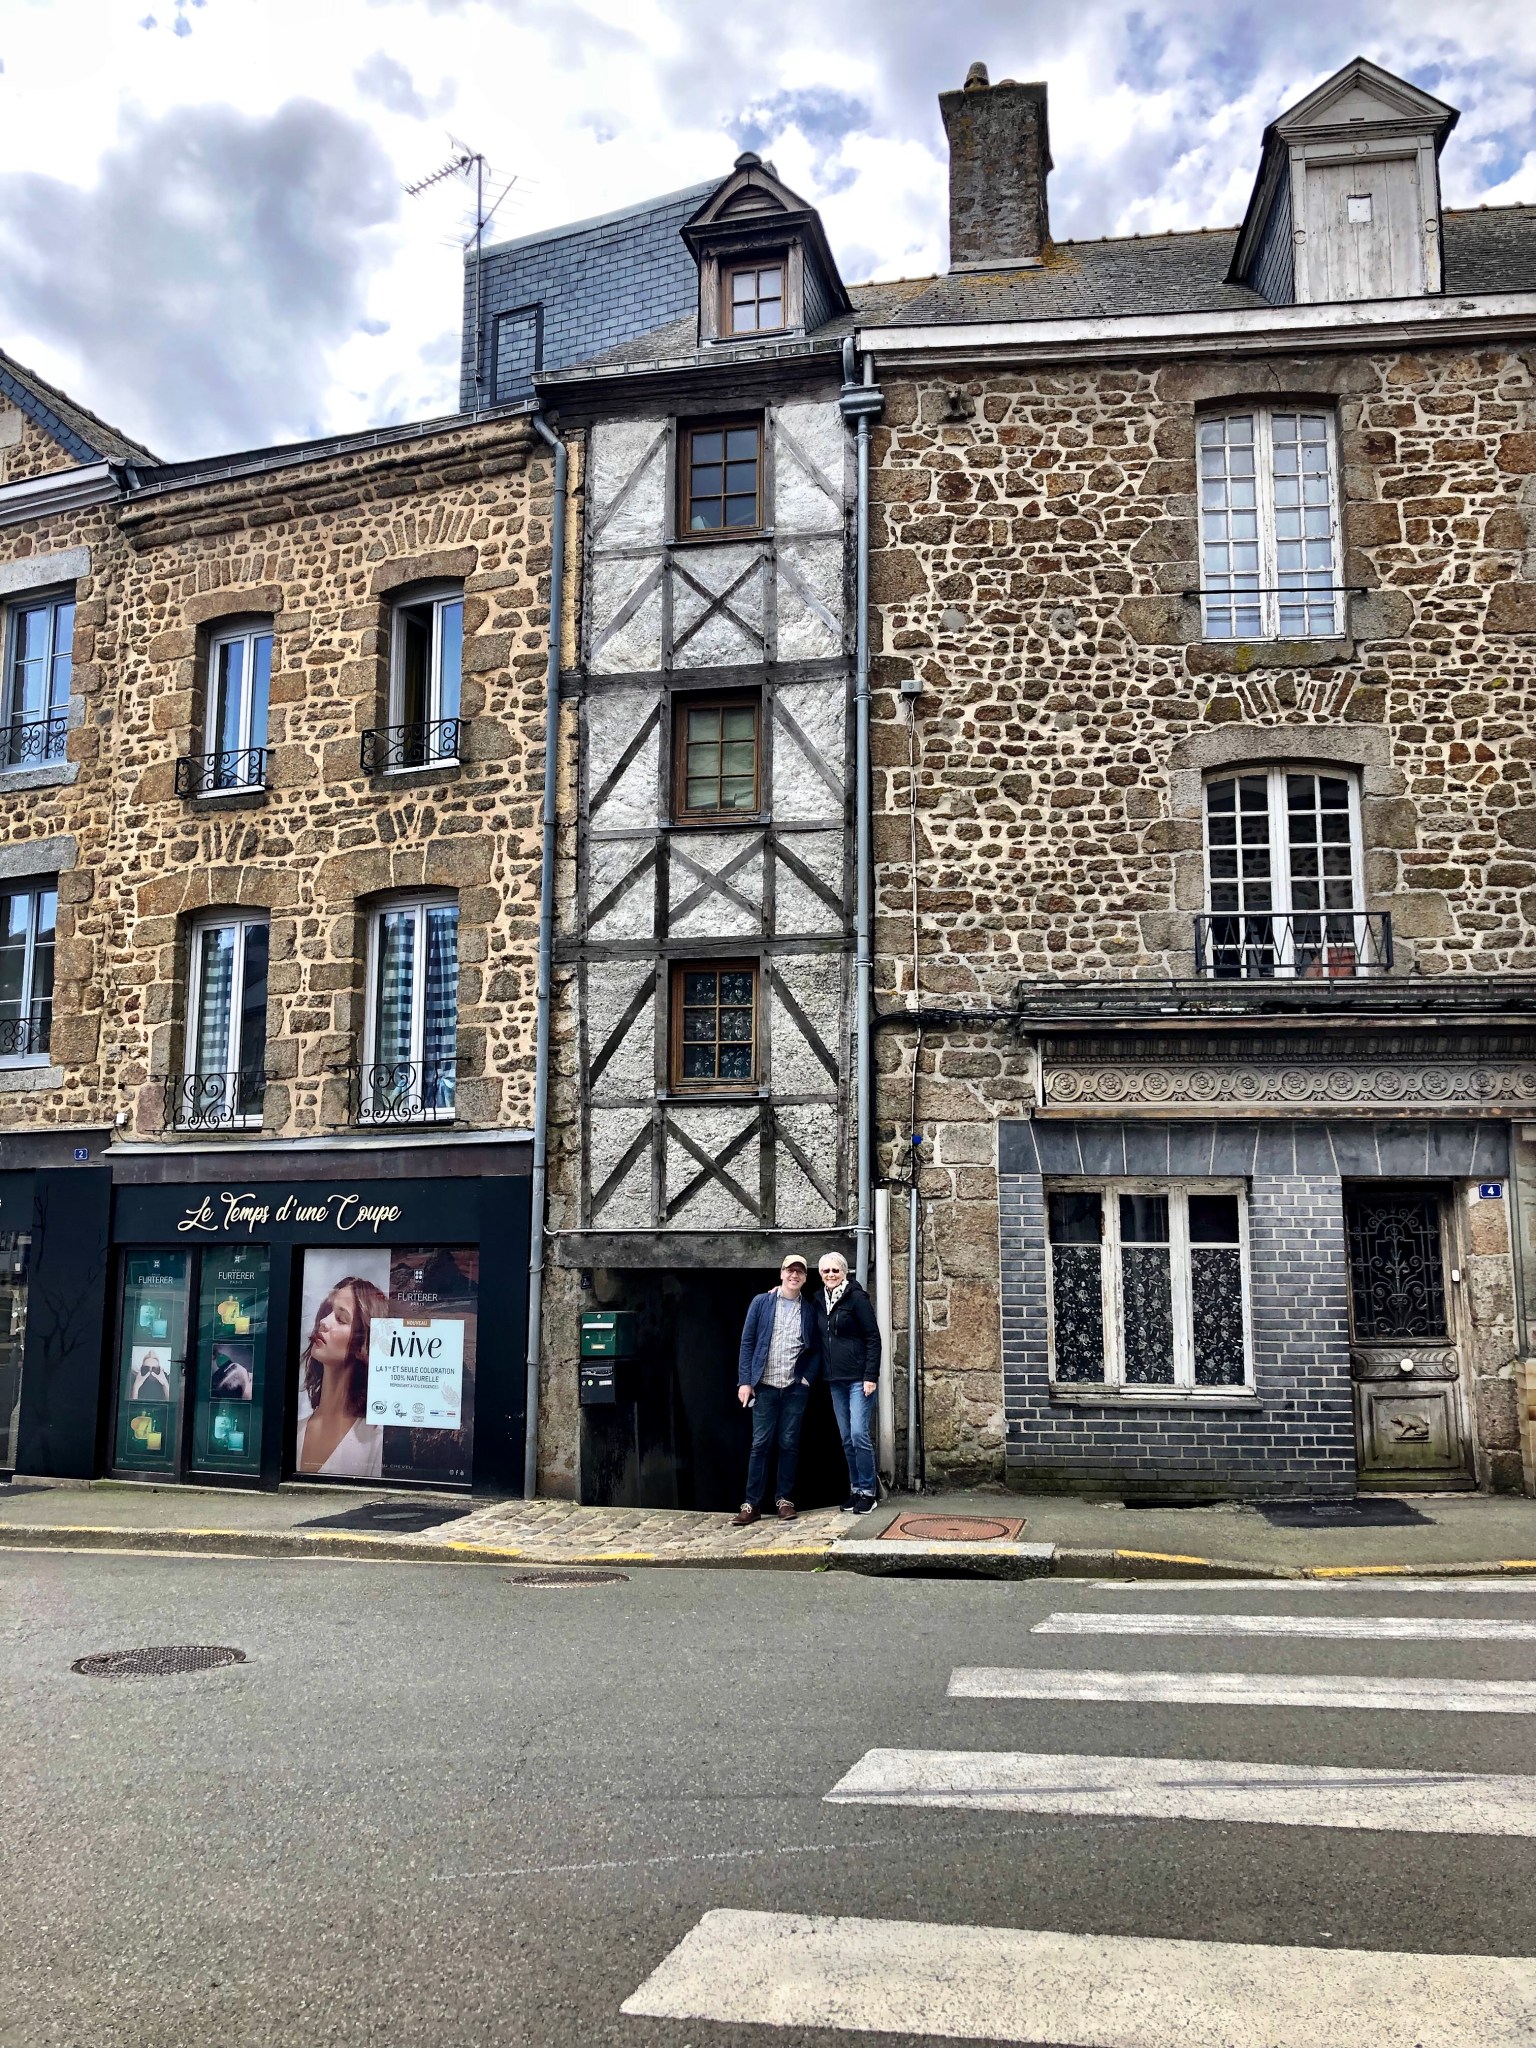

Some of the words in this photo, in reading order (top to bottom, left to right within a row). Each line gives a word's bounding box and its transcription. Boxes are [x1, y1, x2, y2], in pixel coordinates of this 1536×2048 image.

[1488, 1186, 1494, 1196] 4
[177, 1196, 218, 1231] Le
[220, 1192, 270, 1233] Temps
[276, 1194, 329, 1222] d'une
[327, 1194, 401, 1233] Coupe
[138, 1276, 173, 1284] FURTERER
[218, 1271, 255, 1280] FURTERER
[398, 1292, 438, 1302] FURTERER
[390, 1330, 442, 1359] ivive
